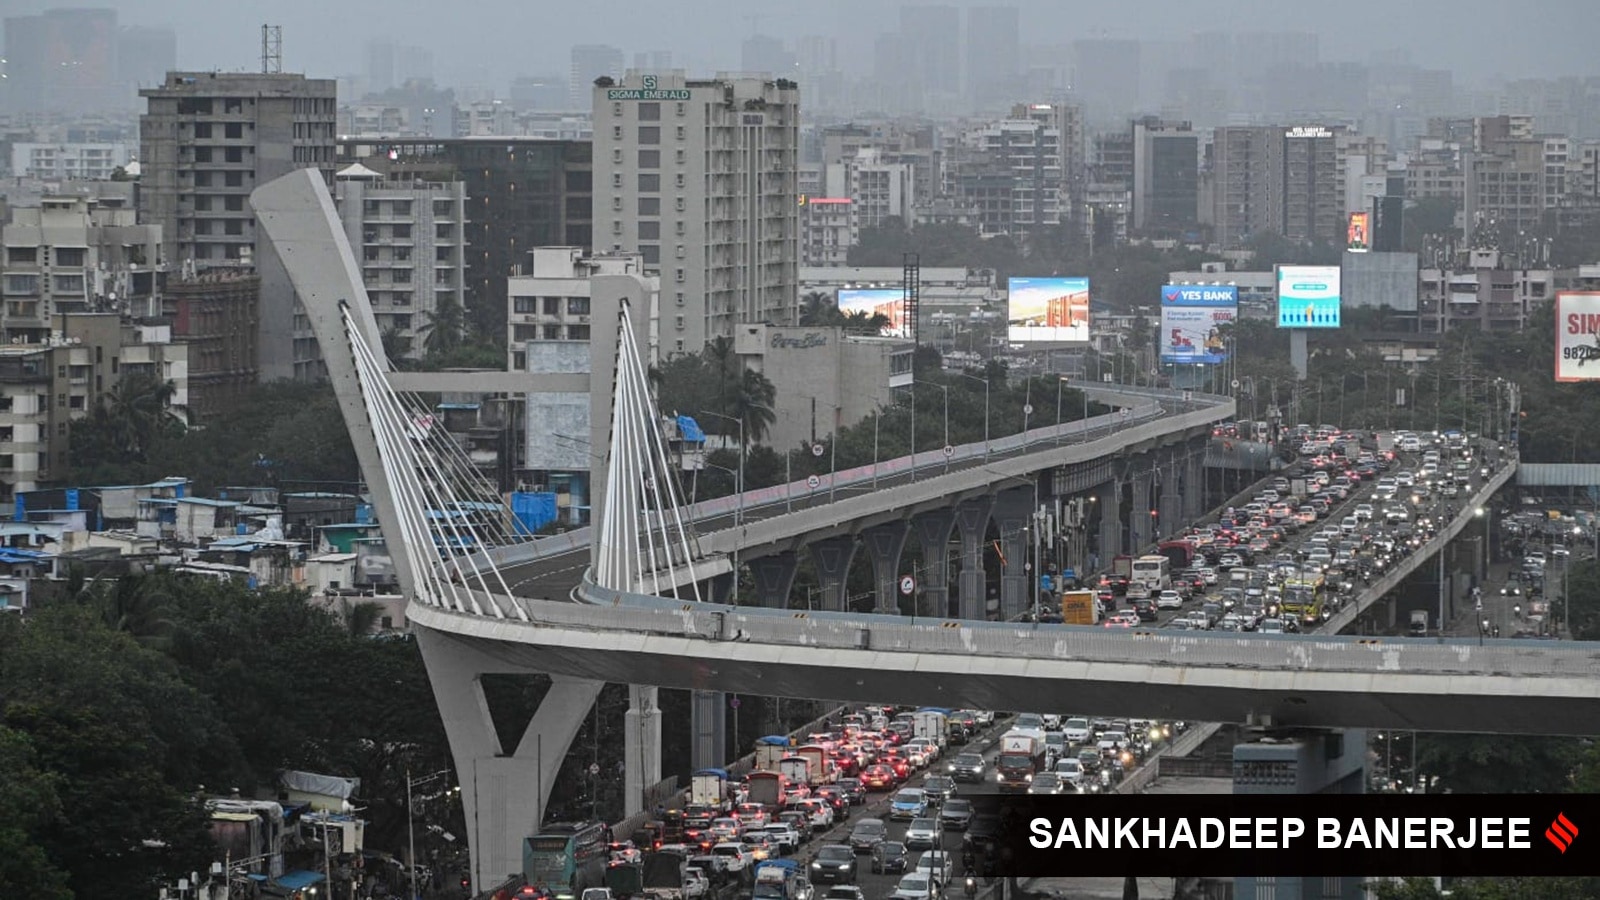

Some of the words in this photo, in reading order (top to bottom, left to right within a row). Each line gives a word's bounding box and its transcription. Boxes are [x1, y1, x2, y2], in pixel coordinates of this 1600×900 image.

[609, 90, 640, 99] SIGMA
[643, 90, 689, 99] EMERALD
[1181, 291, 1201, 301] YES
[1203, 291, 1233, 301] BANK
[1567, 313, 1600, 335] SIM
